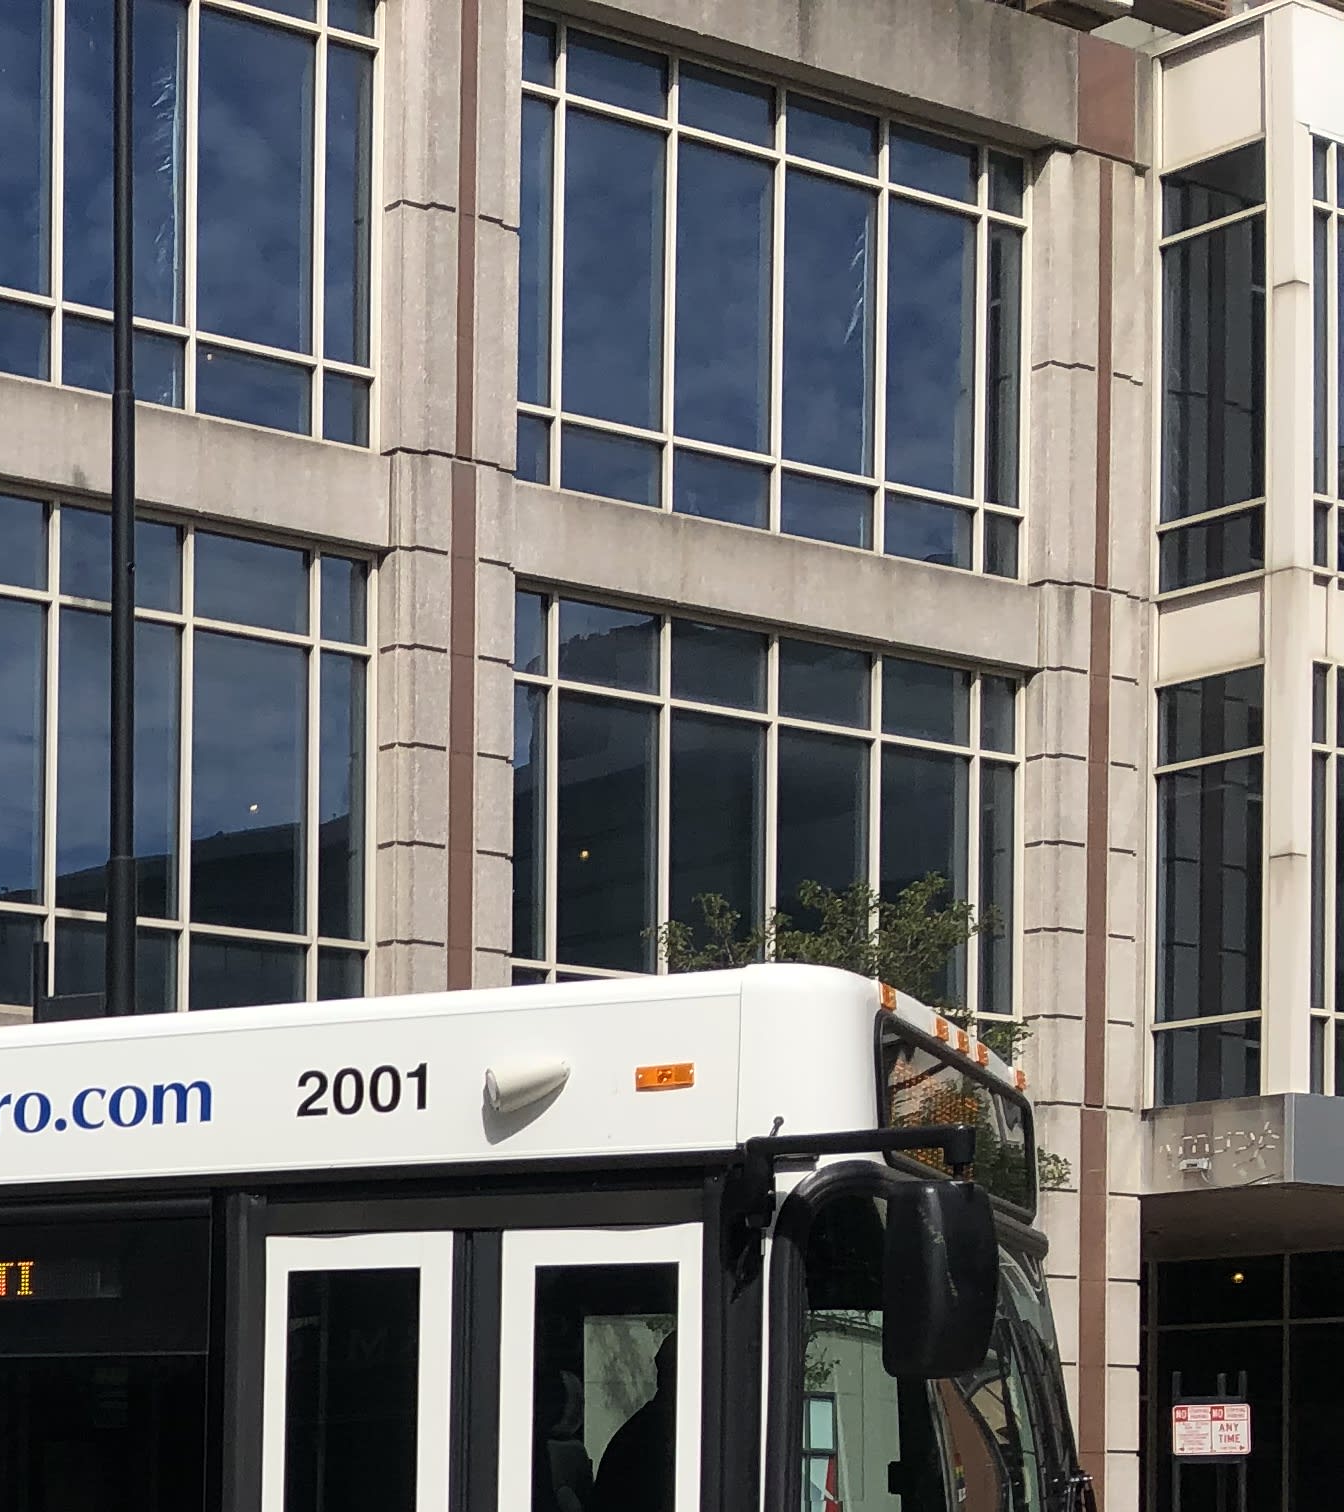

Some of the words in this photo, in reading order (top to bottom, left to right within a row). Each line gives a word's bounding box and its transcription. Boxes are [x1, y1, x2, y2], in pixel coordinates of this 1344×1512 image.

[296, 1061, 429, 1117] 2001
[1219, 1423, 1239, 1432] ANY
[1218, 1433, 1241, 1443] TIME
